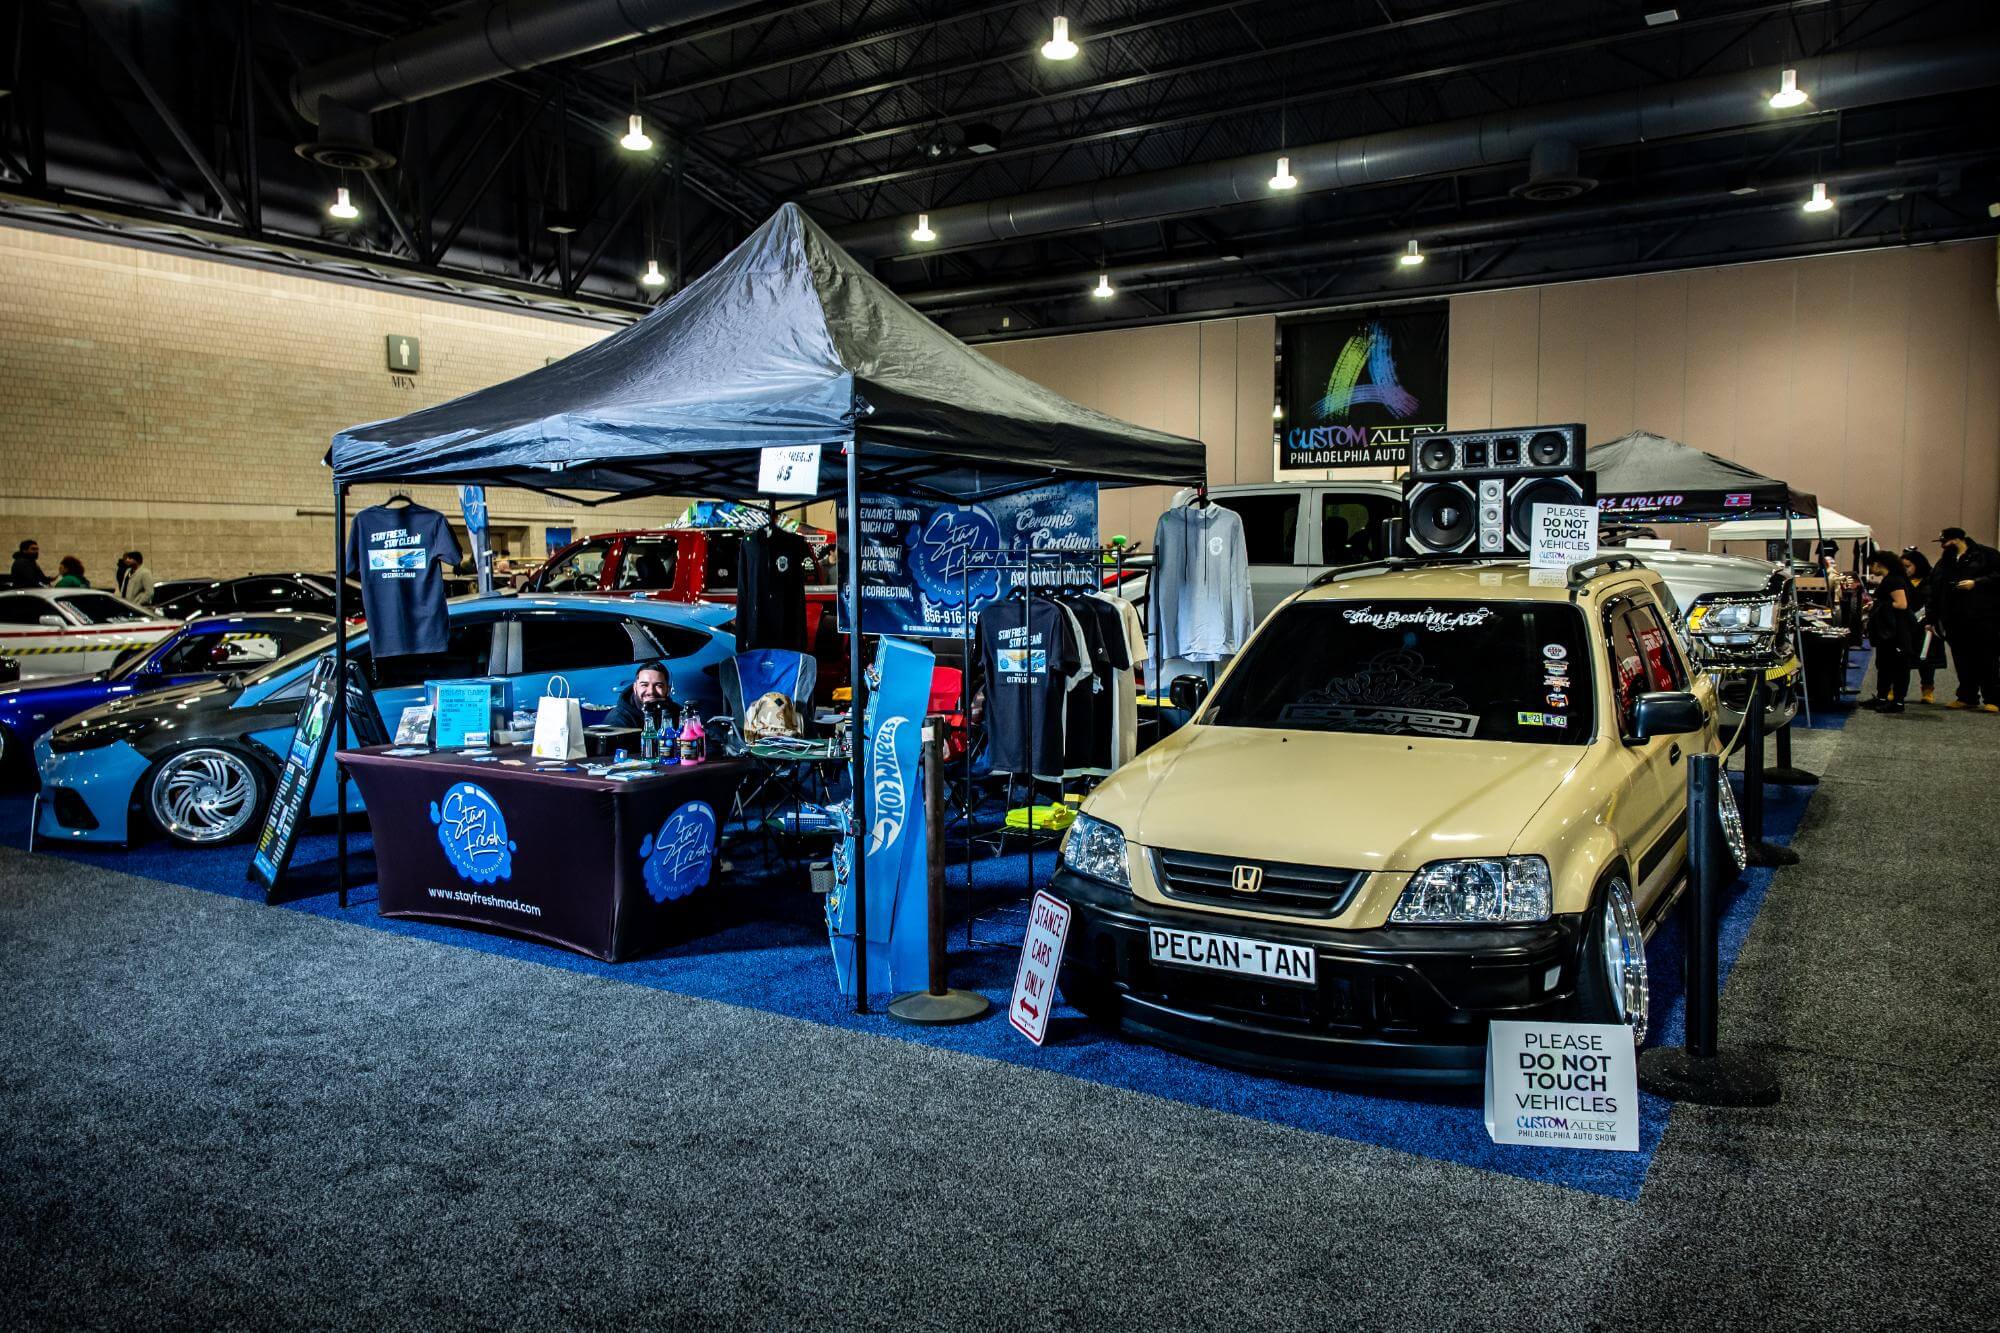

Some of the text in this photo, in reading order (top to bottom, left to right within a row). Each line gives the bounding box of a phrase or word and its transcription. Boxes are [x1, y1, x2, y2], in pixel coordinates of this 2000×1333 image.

[392, 375, 415, 390] MEN
[1288, 425, 1445, 450] CUSTOM ALL
[1290, 448, 1406, 464] PHILADELPHIA AUTO
[1622, 495, 1683, 508] EVOLVED
[894, 509, 918, 521] WASH
[1016, 508, 1075, 531] Ceramic
[1547, 507, 1586, 518] PLEASE
[860, 521, 895, 533] OUCH UP
[1543, 517, 1590, 529] DO NOT
[371, 531, 387, 543] STAY
[923, 512, 980, 562] Stay
[1544, 528, 1586, 540] TOUCH
[384, 539, 399, 549] STAY
[1540, 539, 1590, 551] VEHICLES
[1539, 551, 1565, 559] CUSTOM
[861, 560, 896, 572] AKE OVER
[866, 585, 910, 598] CORRECTION
[933, 584, 952, 596] AUTO
[1349, 610, 1384, 627] Stay
[1385, 611, 1427, 627] Fresh
[998, 628, 1012, 640] STAY
[1009, 637, 1022, 648] STAY
[443, 792, 487, 840] Stay
[462, 820, 506, 862] Fresh
[657, 815, 703, 866] Stay
[462, 861, 478, 873] AUTO
[480, 852, 505, 875] DETAILING
[668, 831, 712, 882] Fresh
[428, 886, 542, 917] www.stayfreshmad.com
[1034, 903, 1064, 939] STANCE
[1031, 938, 1052, 968] CARS
[1153, 930, 1311, 978] PECAN-TAN
[1024, 970, 1045, 1000] ONLY
[1525, 1033, 1603, 1051] PLEASE
[1519, 1053, 1611, 1073] DO NOT
[1523, 1072, 1607, 1092] TOUCH
[1515, 1093, 1617, 1113] VEHICLES
[1516, 1116, 1616, 1132] CUSTOM ALLEY
[1518, 1129, 1617, 1142] PHILADELPHIA AUTO SHOW
